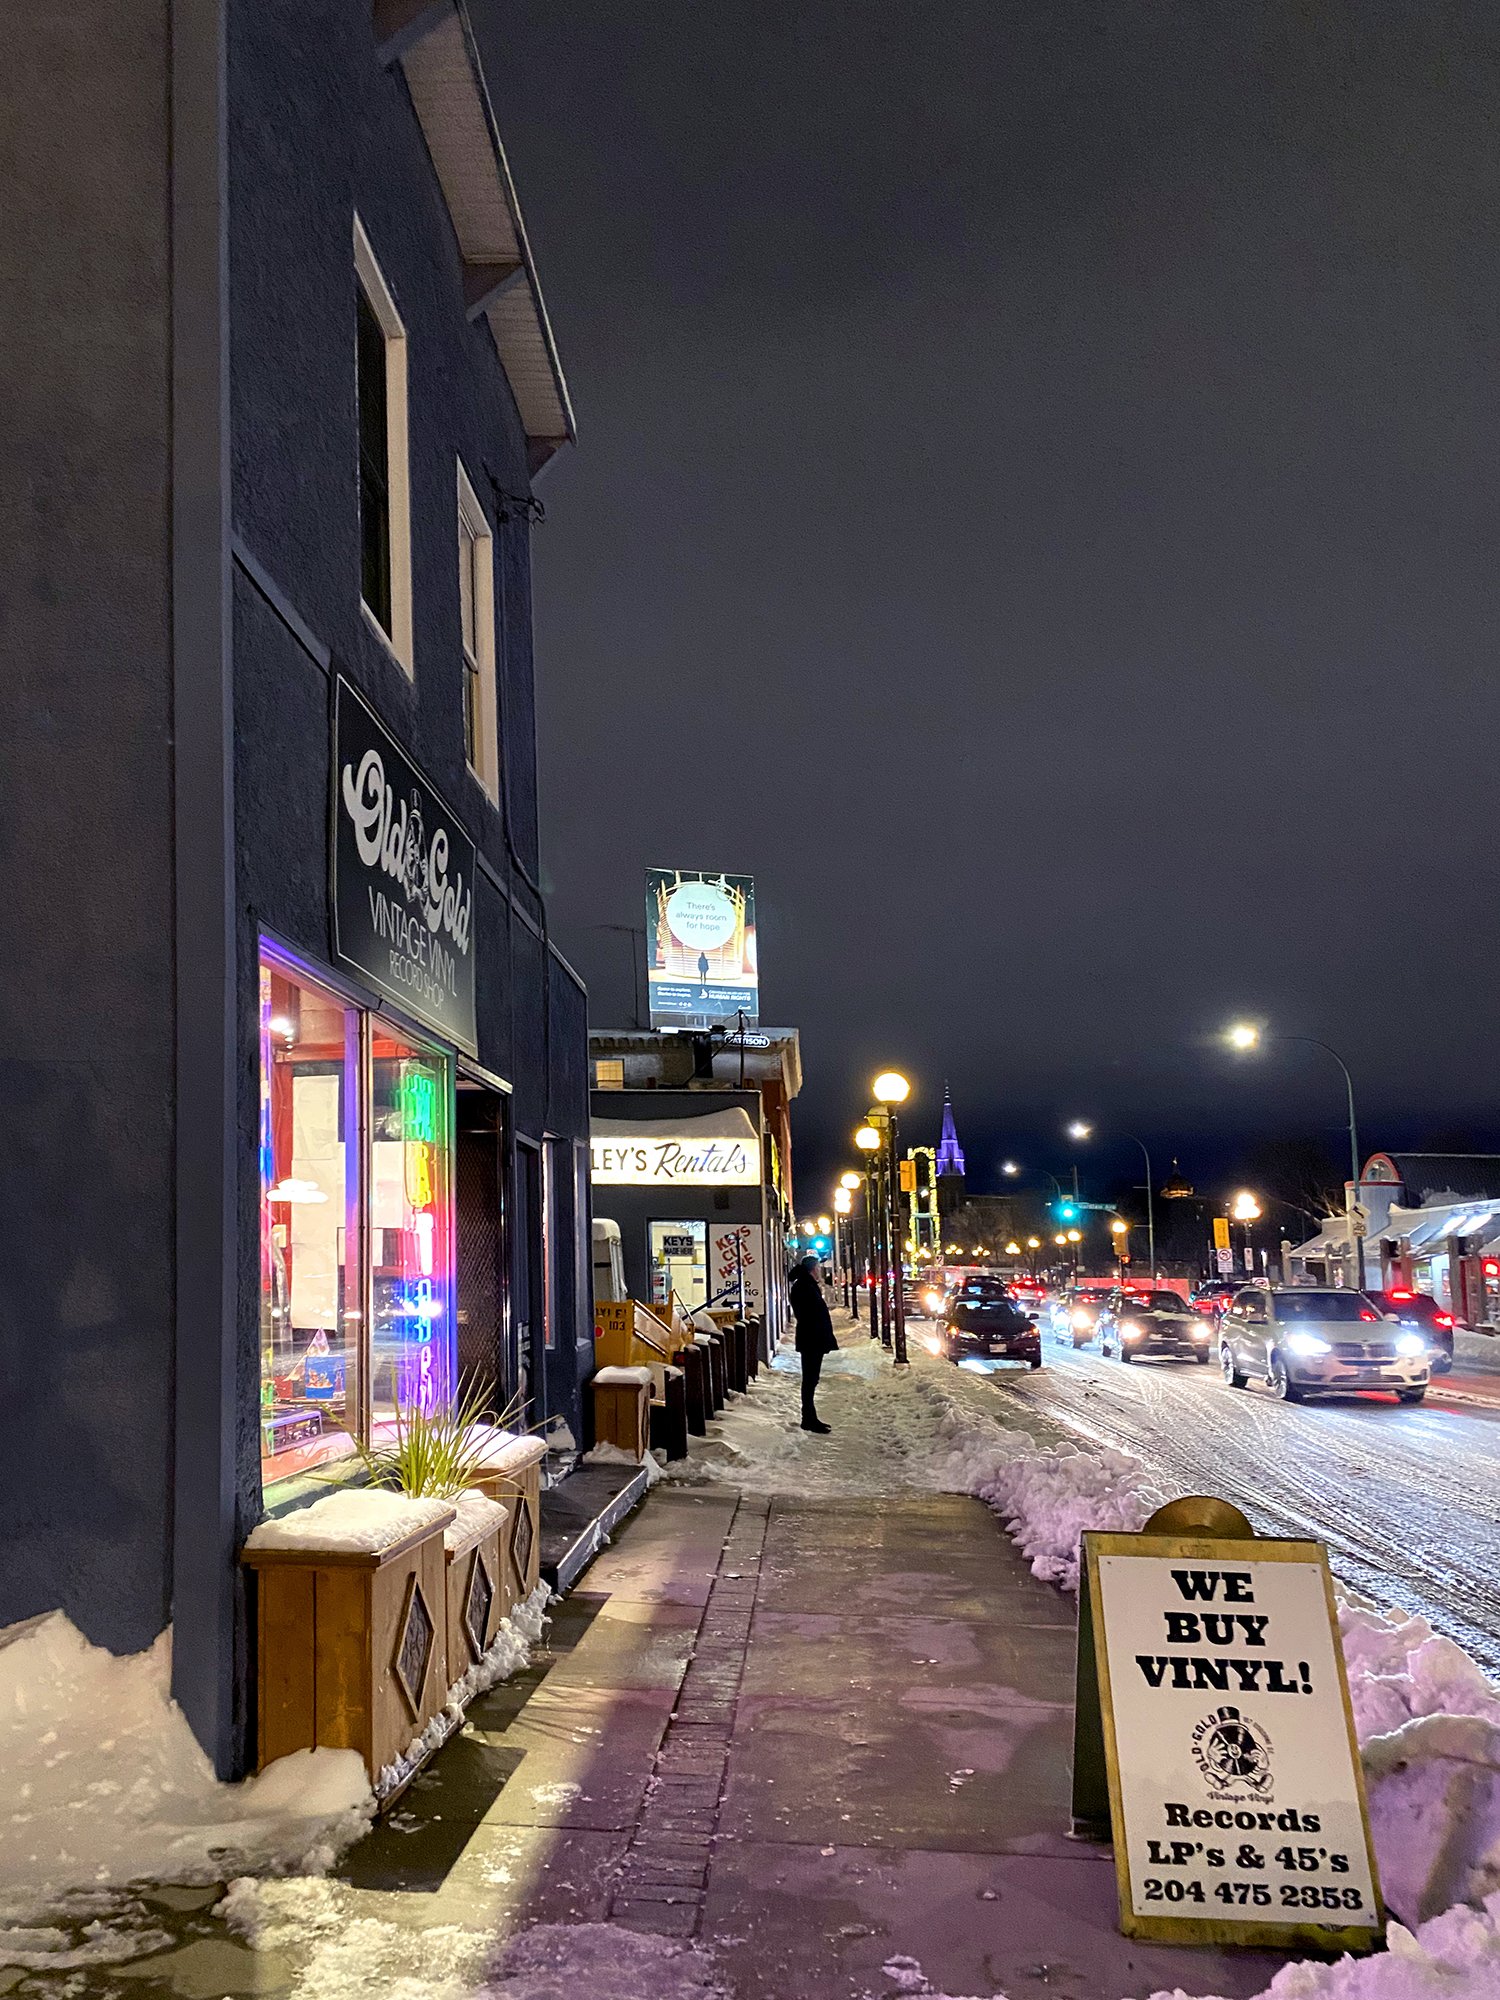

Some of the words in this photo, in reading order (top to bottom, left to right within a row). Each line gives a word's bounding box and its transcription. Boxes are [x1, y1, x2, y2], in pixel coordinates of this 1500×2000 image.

[342, 749, 406, 883] Old
[427, 828, 471, 955] Gold
[675, 911, 703, 921] always
[687, 902, 716, 910] There's
[368, 885, 427, 967] VINTAGE
[428, 932, 457, 997] VINYL
[686, 921, 698, 929] for
[699, 922, 720, 931] hope
[389, 949, 423, 992] RECORD
[423, 973, 445, 1009] SHOP
[653, 1142, 754, 1178] Rentals
[663, 1235, 693, 1246] KEYS
[725, 1280, 752, 1288] RER
[609, 1320, 626, 1331] 103
[1170, 1569, 1255, 1603] WE
[1163, 1611, 1269, 1646] BUY
[1135, 1655, 1313, 1695] VINYL!
[1164, 1803, 1321, 1833] Records
[1147, 1840, 1226, 1867] LP's
[1235, 1844, 1266, 1869] &
[1274, 1846, 1350, 1873] 45's
[1144, 1879, 1206, 1903] 204
[1214, 1882, 1272, 1906] 475
[1279, 1885, 1364, 1910] 2353
